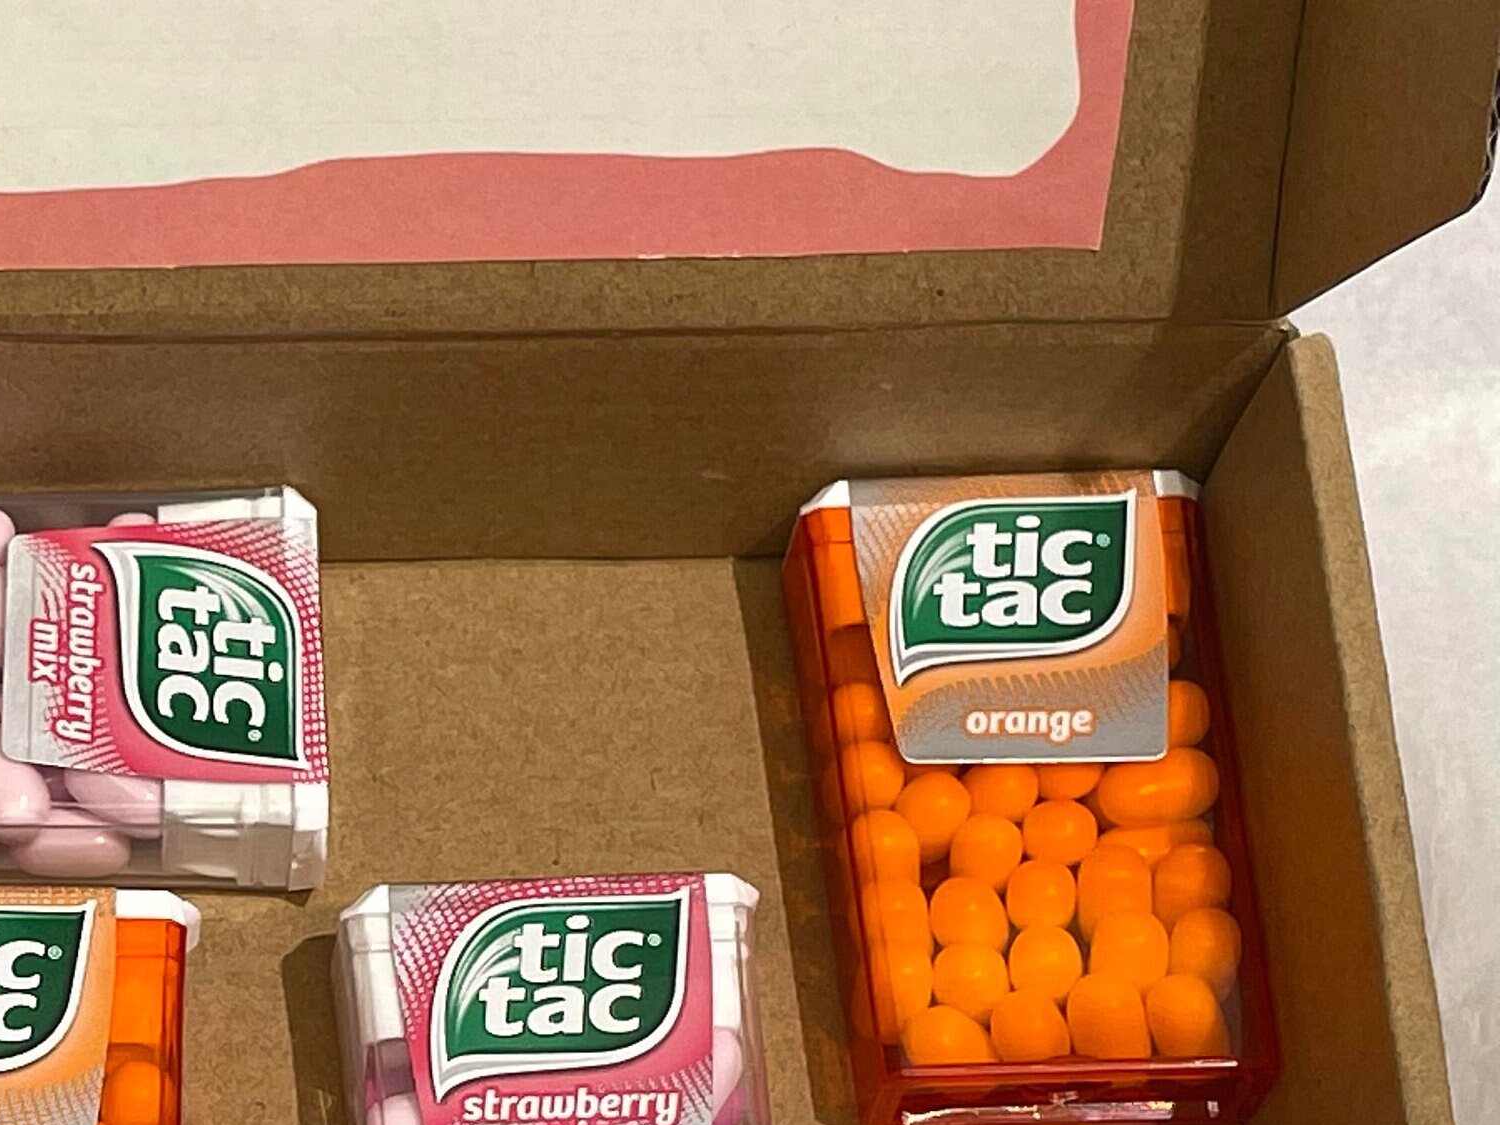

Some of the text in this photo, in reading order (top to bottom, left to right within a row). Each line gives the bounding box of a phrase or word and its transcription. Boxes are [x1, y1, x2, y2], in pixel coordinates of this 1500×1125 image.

[967, 516, 1093, 577] tic
[933, 572, 1092, 627] tac
[33, 622, 66, 681] mix
[56, 564, 102, 741] strawberry
[158, 585, 221, 721] tac
[213, 617, 284, 727] tic
[966, 709, 1092, 741] orange
[513, 915, 646, 983] tic
[479, 977, 642, 1036] tac
[464, 1088, 679, 1125] strawberry
